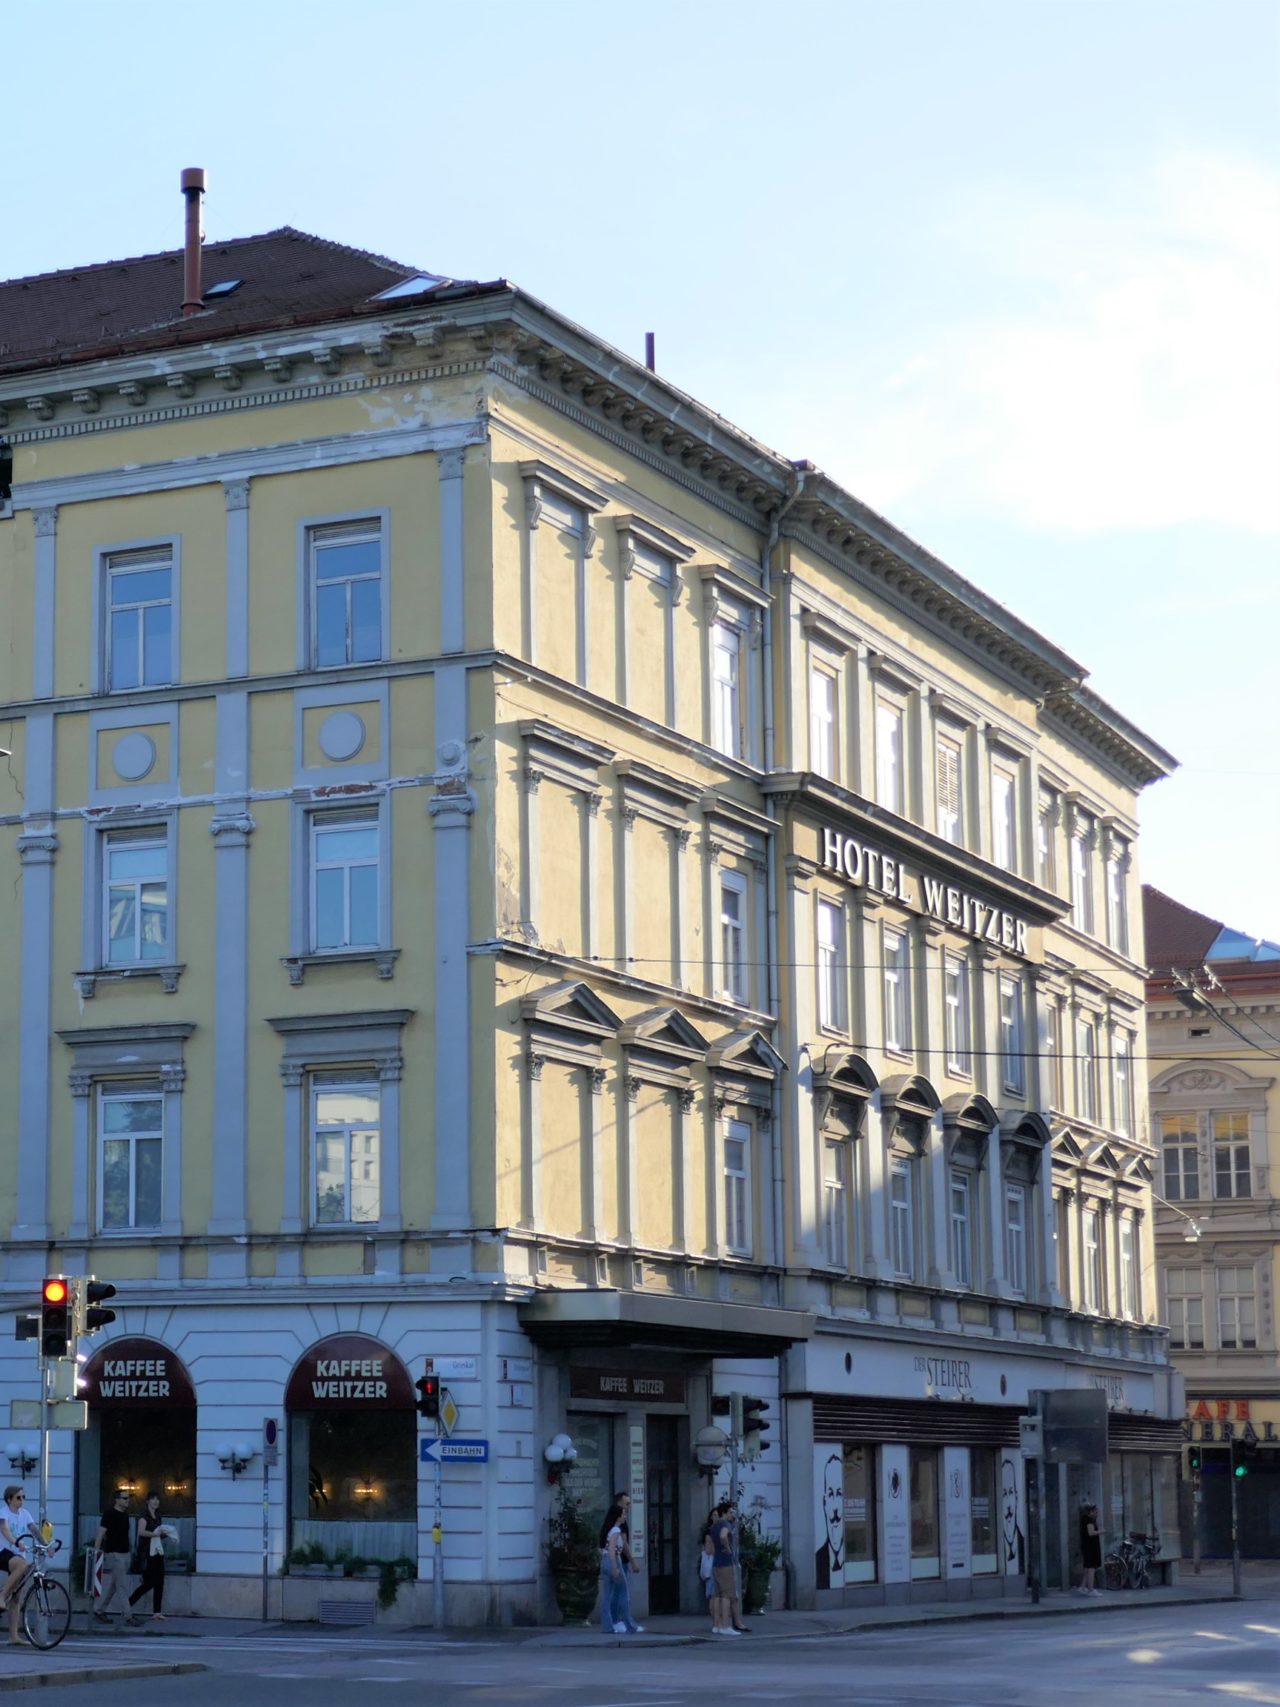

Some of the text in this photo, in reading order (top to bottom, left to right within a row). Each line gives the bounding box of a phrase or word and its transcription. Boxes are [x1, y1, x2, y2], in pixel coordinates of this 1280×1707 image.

[822, 827, 1029, 955] HOTEL WEITZER
[103, 1360, 166, 1377] KAFFEE
[316, 1360, 383, 1377] KAFFEE
[926, 1357, 972, 1395] STEIRER
[99, 1380, 170, 1397] WEITZER
[312, 1381, 387, 1398] WEITZER
[600, 1376, 664, 1395] KAFFEE WEITZER
[1185, 1399, 1249, 1420] AFE
[442, 1446, 482, 1455] EINBAHN
